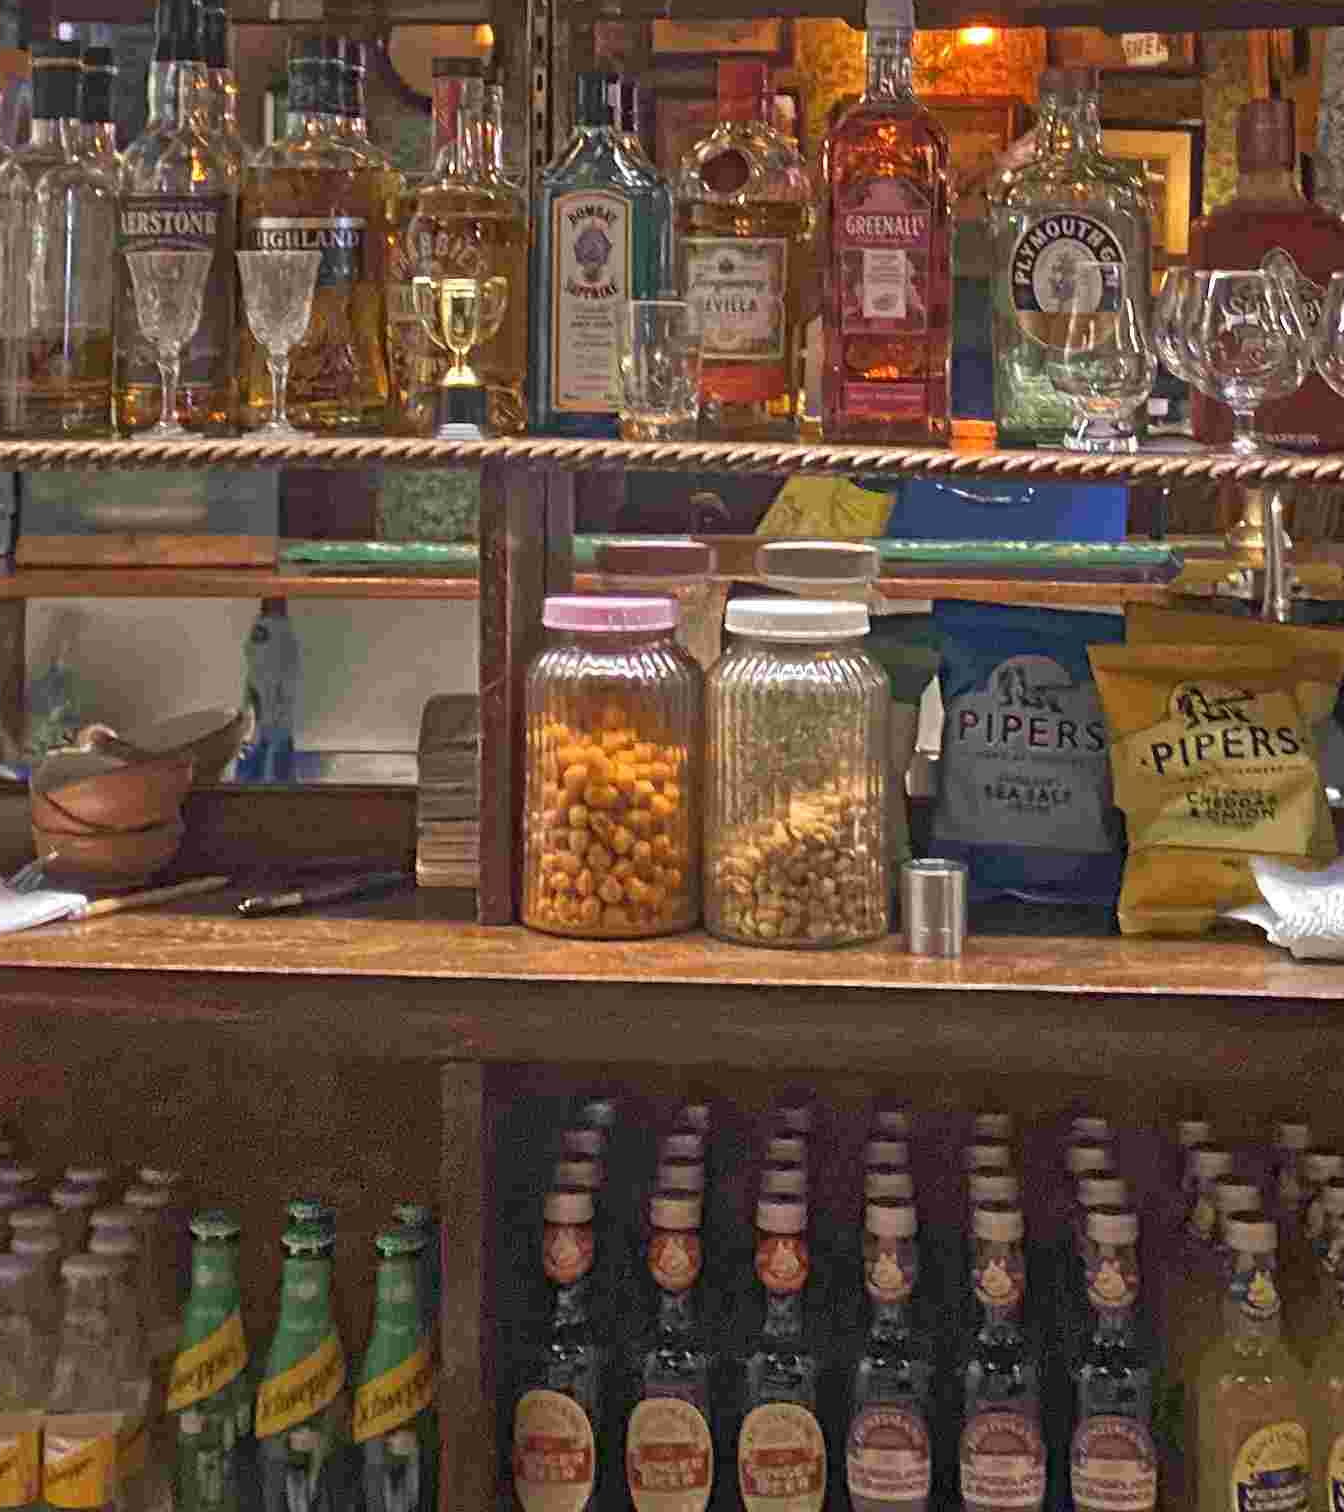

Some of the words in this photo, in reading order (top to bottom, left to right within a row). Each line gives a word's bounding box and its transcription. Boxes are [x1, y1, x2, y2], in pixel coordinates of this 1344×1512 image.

[120, 211, 217, 235] AERSTONE
[567, 205, 618, 226] BOMBAY
[1014, 217, 1105, 285] PLYMOUTH
[958, 709, 1105, 753] PIPERS
[1150, 725, 1300, 776] PIPERS
